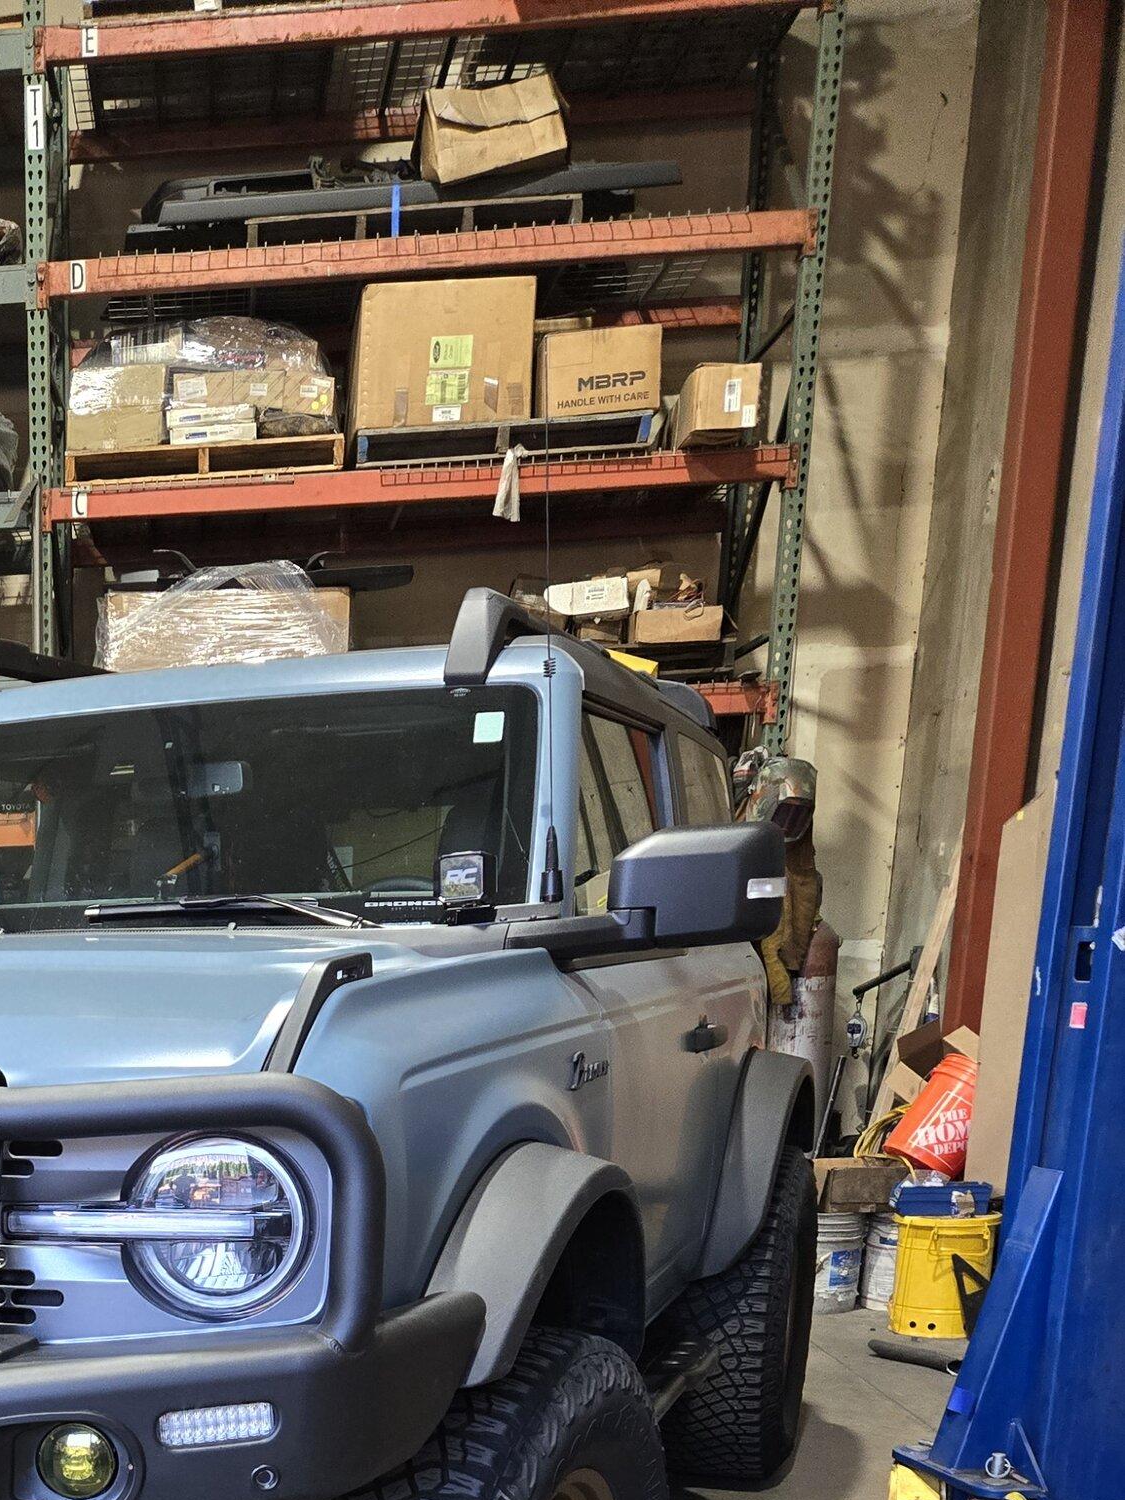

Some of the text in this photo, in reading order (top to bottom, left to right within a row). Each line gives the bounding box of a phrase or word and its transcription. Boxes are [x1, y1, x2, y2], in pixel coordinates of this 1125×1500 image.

[86, 26, 95, 54] E
[72, 263, 83, 289] D
[577, 370, 646, 392] MBRP
[557, 391, 650, 409] HANDLE WITH CARE
[75, 491, 84, 515] C
[939, 1109, 967, 1122] THE
[917, 1119, 971, 1147] HOM
[933, 1141, 967, 1156] DEP
